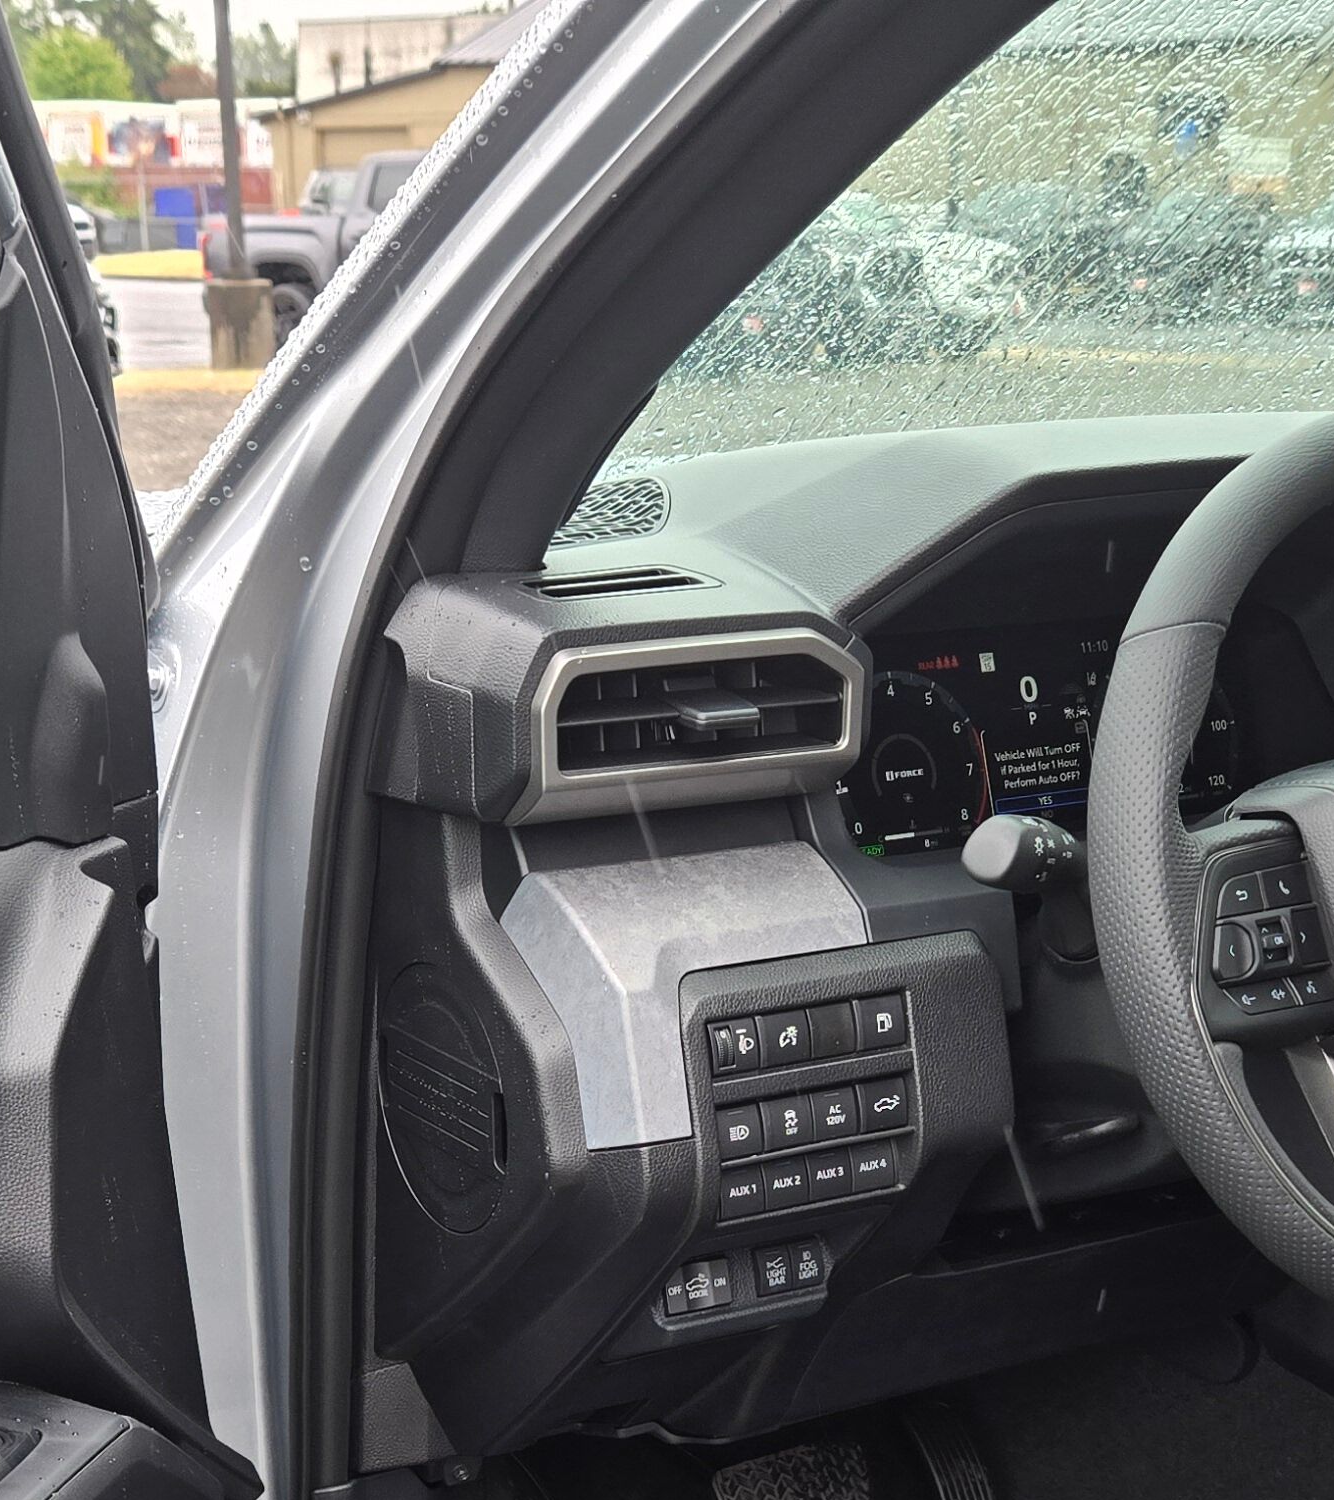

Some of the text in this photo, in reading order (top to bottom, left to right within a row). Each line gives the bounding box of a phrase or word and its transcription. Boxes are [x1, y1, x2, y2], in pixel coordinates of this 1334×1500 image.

[1080, 639, 1109, 654] 11:10
[886, 684, 895, 697] 4
[1020, 675, 1038, 703] 0
[925, 691, 933, 705] 5
[1029, 711, 1037, 726] P
[1210, 719, 1227, 731] 100
[952, 721, 961, 734] 6
[994, 742, 1081, 762] Vehicle Will Turn OFF
[966, 763, 973, 776] 7
[1000, 765, 1006, 776] if
[1008, 762, 1037, 775] Parked
[1038, 760, 1050, 771] for
[1057, 758, 1080, 769] Hour,
[1004, 770, 1081, 790] Perform Auto OFF?
[1208, 774, 1225, 786] 120
[1038, 795, 1053, 806] YES
[961, 808, 969, 821] 8
[854, 822, 863, 835] 0
[829, 1104, 842, 1115] AC
[826, 1114, 846, 1126] 120V
[785, 1126, 799, 1136] OFF
[859, 1158, 888, 1173] AUX 4
[816, 1166, 845, 1181] AUX 3
[772, 1175, 802, 1190] AUX 2
[729, 1183, 757, 1198] AUX 1
[799, 1259, 817, 1271] FOG
[766, 1267, 787, 1279] LIGHT
[798, 1268, 819, 1280] LIGHT
[713, 1277, 727, 1288] ON
[768, 1276, 786, 1287] BAR
[667, 1285, 683, 1296] OFF
